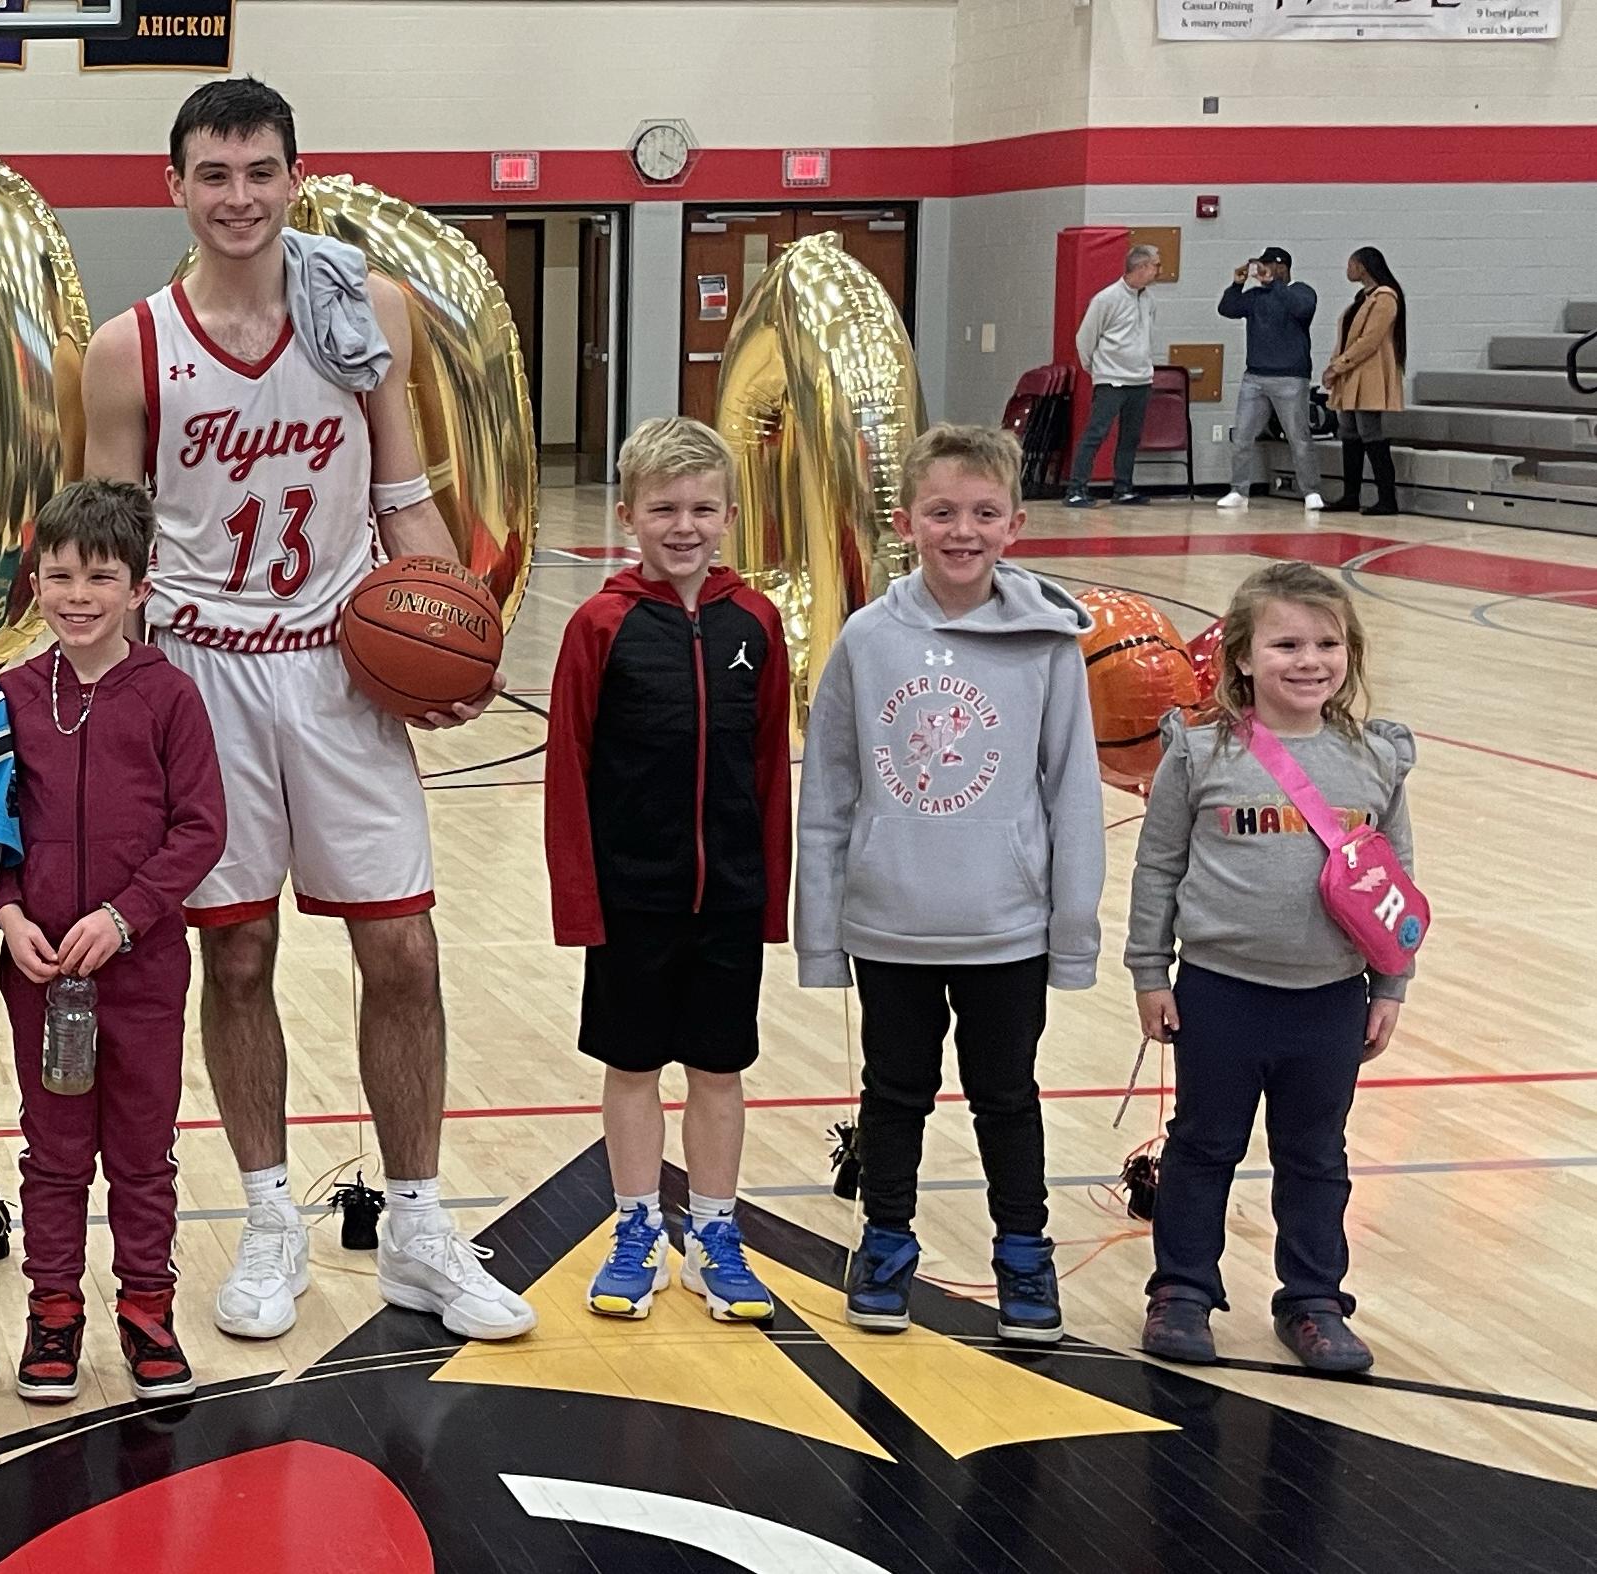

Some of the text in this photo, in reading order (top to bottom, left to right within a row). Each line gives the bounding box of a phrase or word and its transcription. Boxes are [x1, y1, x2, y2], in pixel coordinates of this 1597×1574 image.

[136, 15, 226, 37] AHICKON
[1181, 18, 1253, 29] & many more!
[1182, 1, 1253, 13] Casual Dining
[1476, 8, 1539, 20] 9 best places
[1516, 24, 1548, 35] game!
[179, 406, 345, 482] Flying
[219, 483, 318, 601] 13
[170, 598, 343, 654] Cardinal
[386, 587, 490, 643] SPALDING
[880, 675, 1000, 729] UPPER DUBLIN
[874, 746, 1001, 815] FLYING CARDINALS
[1373, 883, 1405, 932] R
